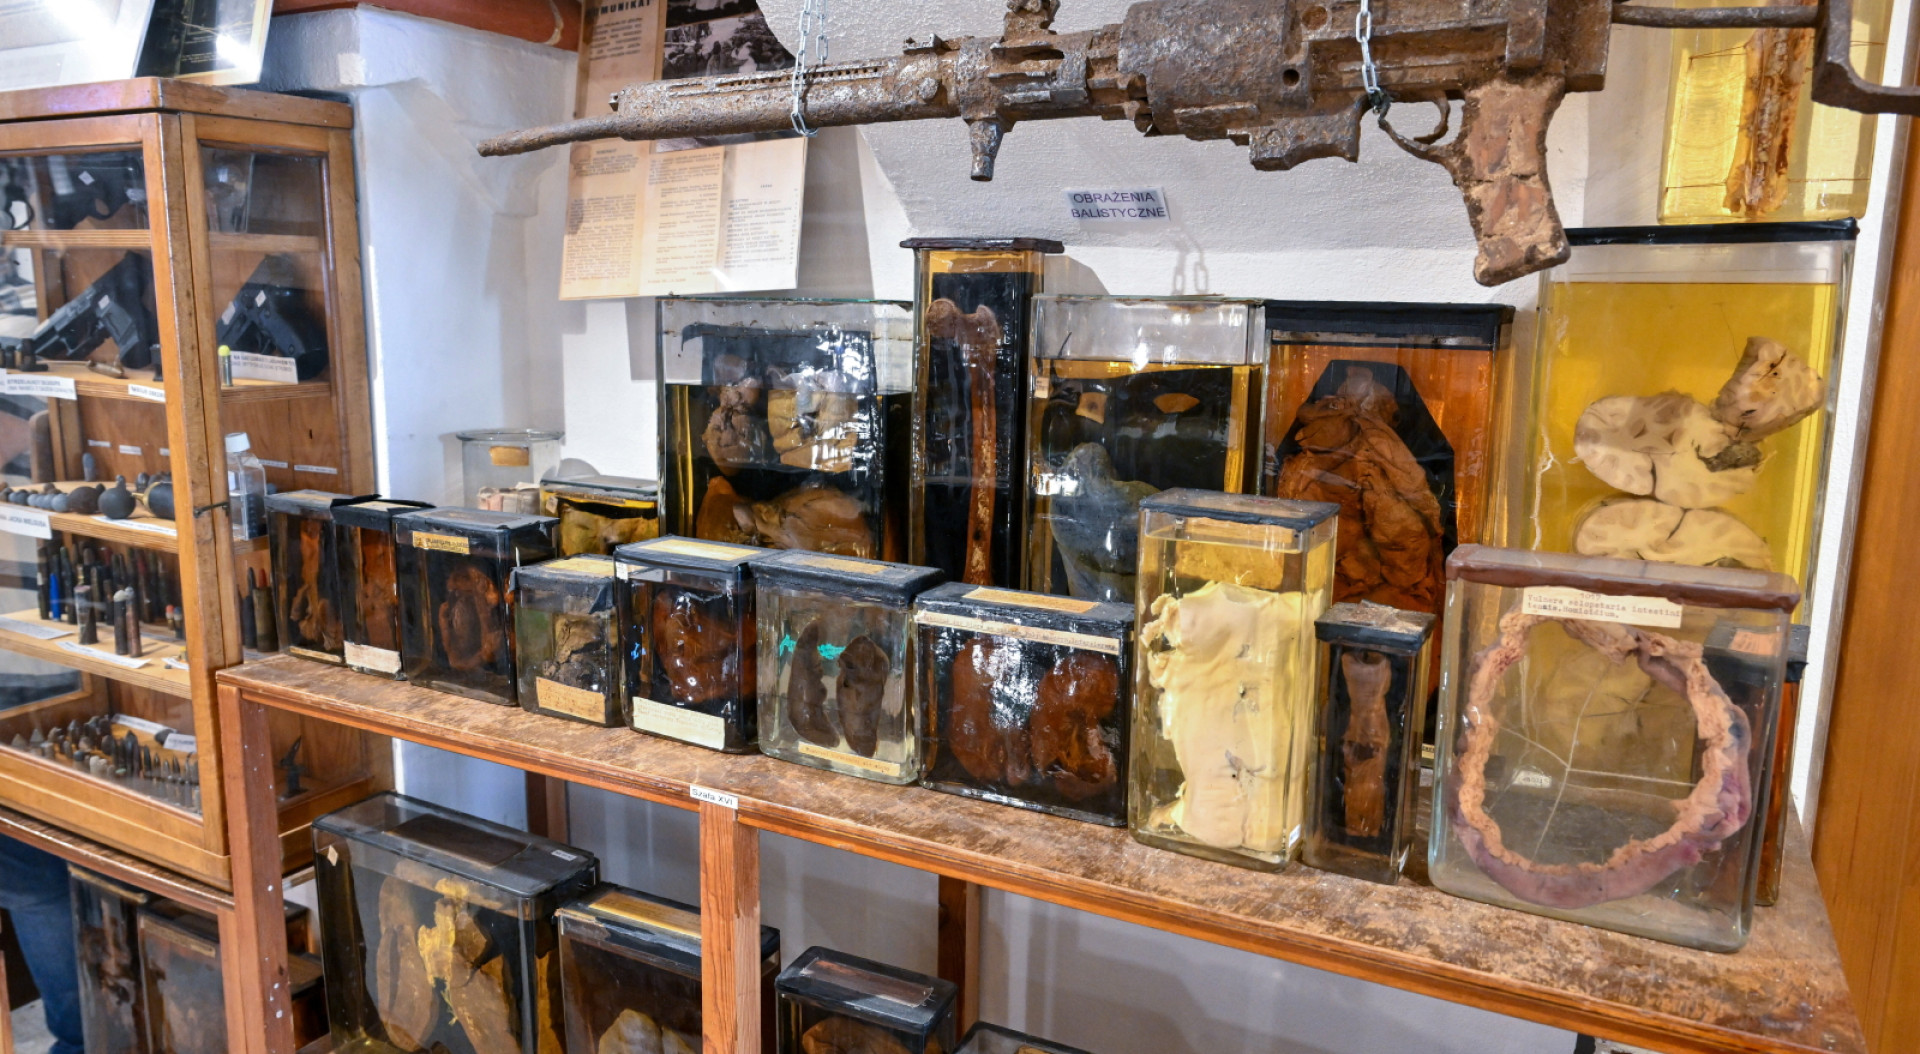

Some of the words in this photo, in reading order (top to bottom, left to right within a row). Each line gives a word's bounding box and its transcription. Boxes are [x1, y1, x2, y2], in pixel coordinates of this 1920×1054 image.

[1073, 191, 1155, 203] OBRAŻENIA
[1071, 207, 1166, 218] BALISTYCZNE
[692, 788, 715, 801] Szafa
[718, 795, 733, 805] XVI
